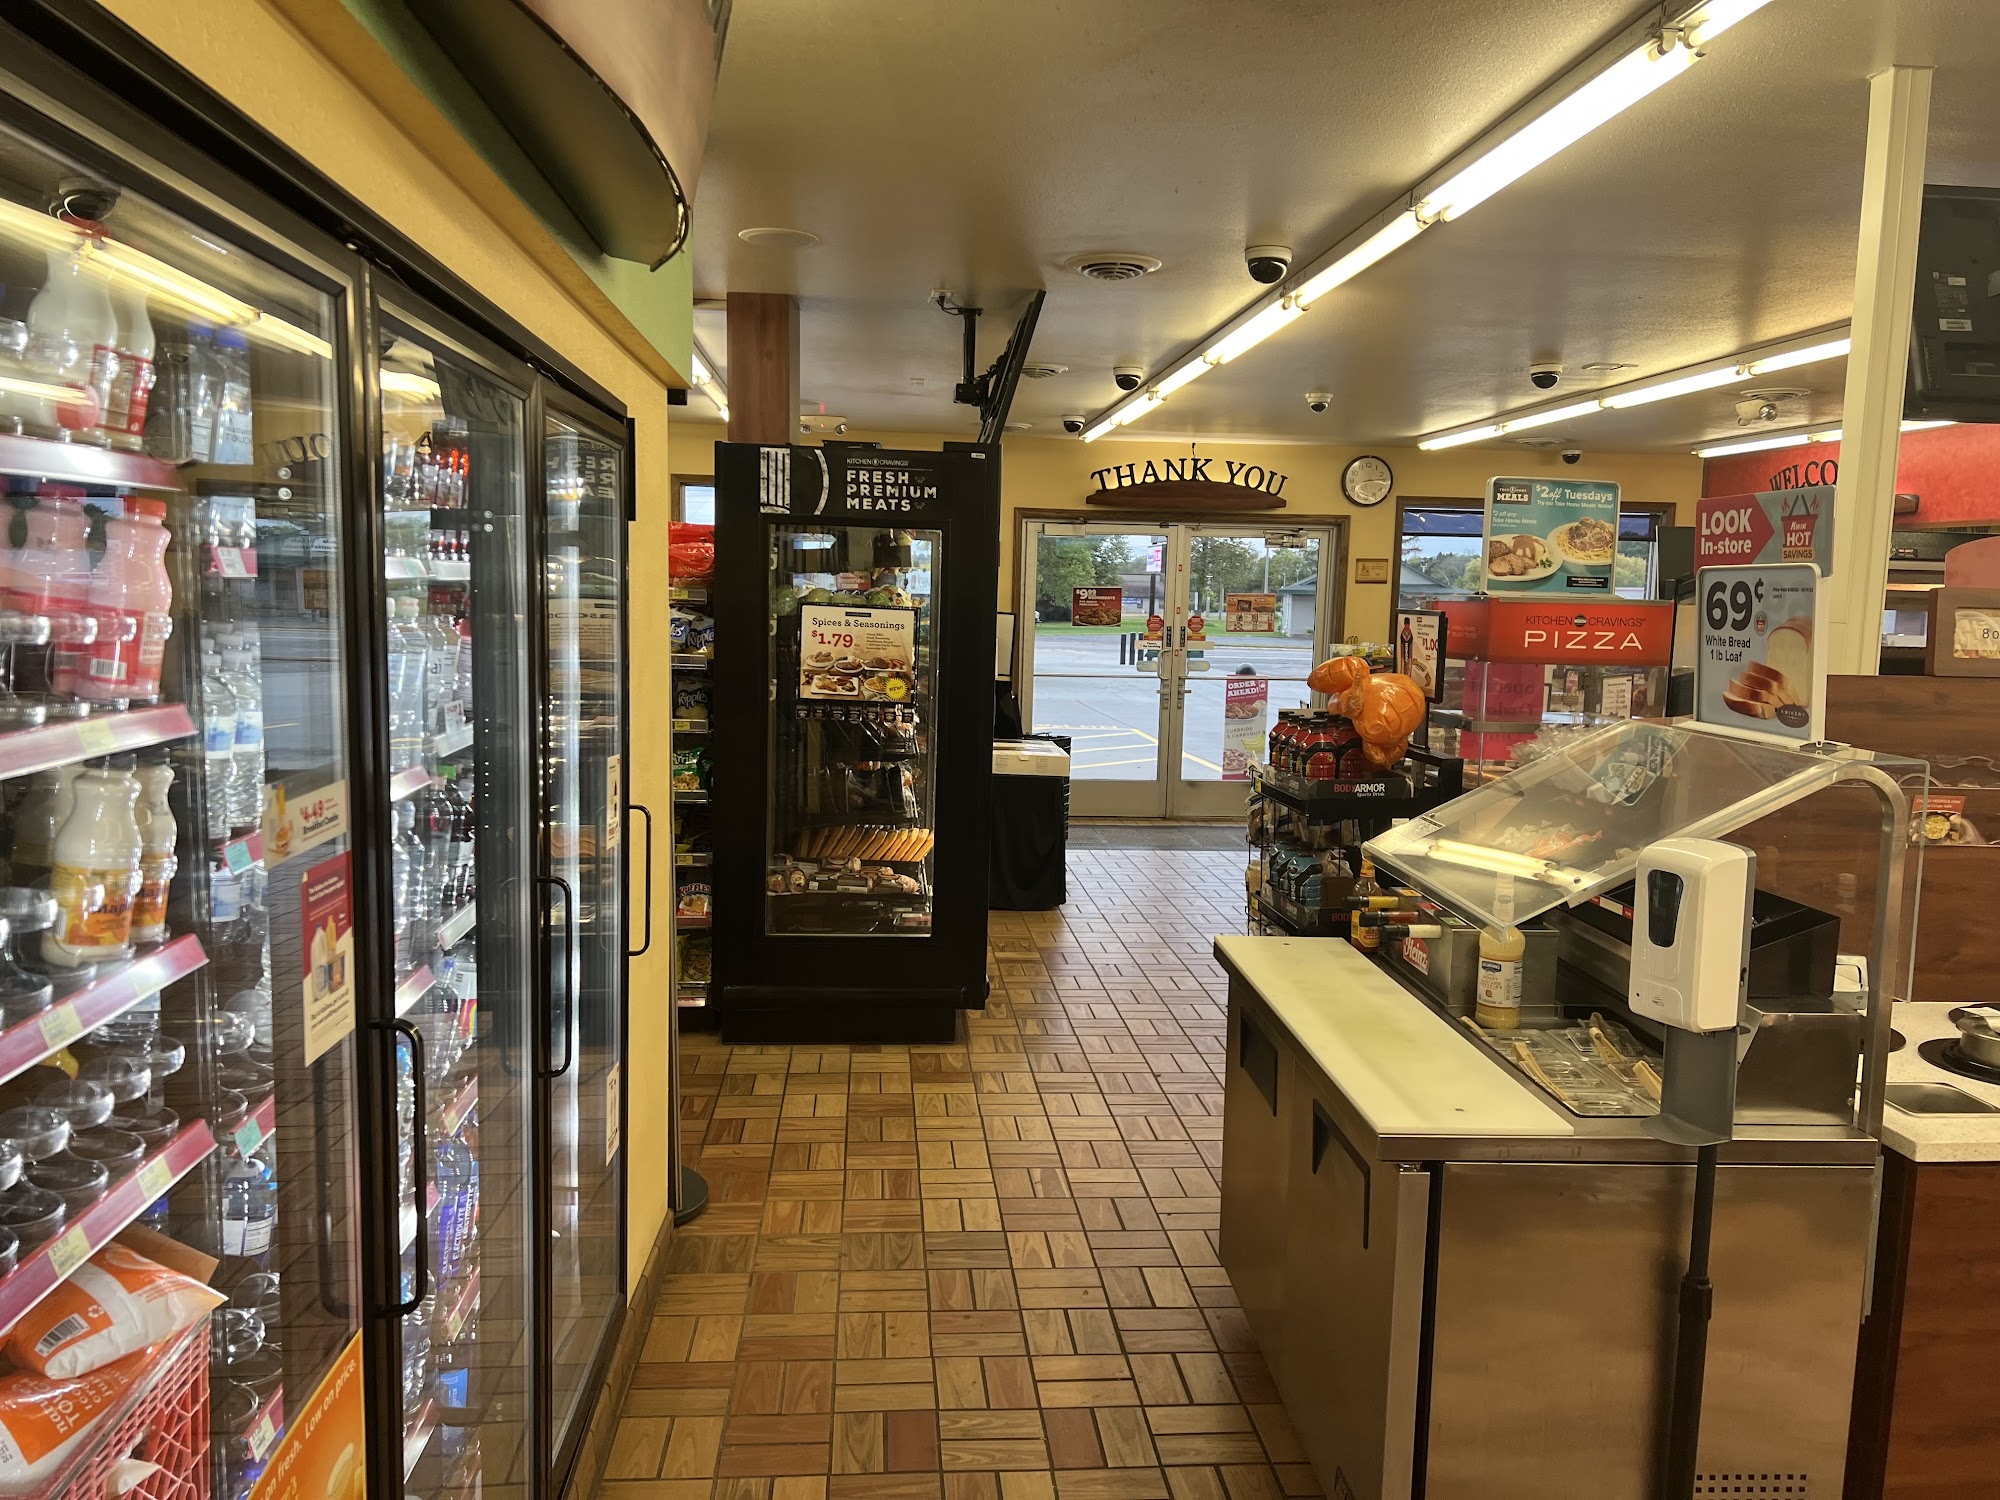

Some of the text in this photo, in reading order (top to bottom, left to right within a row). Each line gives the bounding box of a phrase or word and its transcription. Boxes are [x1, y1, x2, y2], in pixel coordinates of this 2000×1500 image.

[846, 469, 909, 484] FRESH
[1090, 458, 1288, 496] THANK YOU
[1769, 460, 1839, 492] WELCO
[846, 483, 937, 499] PREMIUM
[1496, 492, 1529, 502] MEALS
[1536, 484, 1613, 503] $2 off Tuesdays
[846, 497, 911, 512] MEATS
[1701, 508, 1752, 535] LOOK
[1701, 538, 1752, 555] In-store
[1786, 531, 1812, 547] HOT
[1783, 549, 1813, 559] SAVINGS
[812, 617, 905, 631] Spices & Seasonings
[1525, 616, 1643, 627] KITCHEN CRAVINGS
[687, 628, 715, 648] Ripple
[811, 630, 854, 648] $1.79
[1524, 630, 1643, 650] PIZZA
[1705, 635, 1751, 649] White Bread
[1710, 649, 1743, 663] 1 lb Loaf
[1227, 687, 1260, 698] AHEAD!
[1228, 680, 1256, 690] ORDER
[677, 690, 708, 709] Ripples
[1226, 726, 1253, 734] CURBSIDE
[1232, 730, 1262, 739] CARRYOUT
[679, 882, 712, 895] RUFFLES
[452, 1207, 466, 1260] ELECTROLYTE
[277, 1439, 303, 1482] fresh.
[304, 1403, 323, 1440] Low
[323, 1388, 335, 1410] on
[335, 1358, 357, 1399] price.
